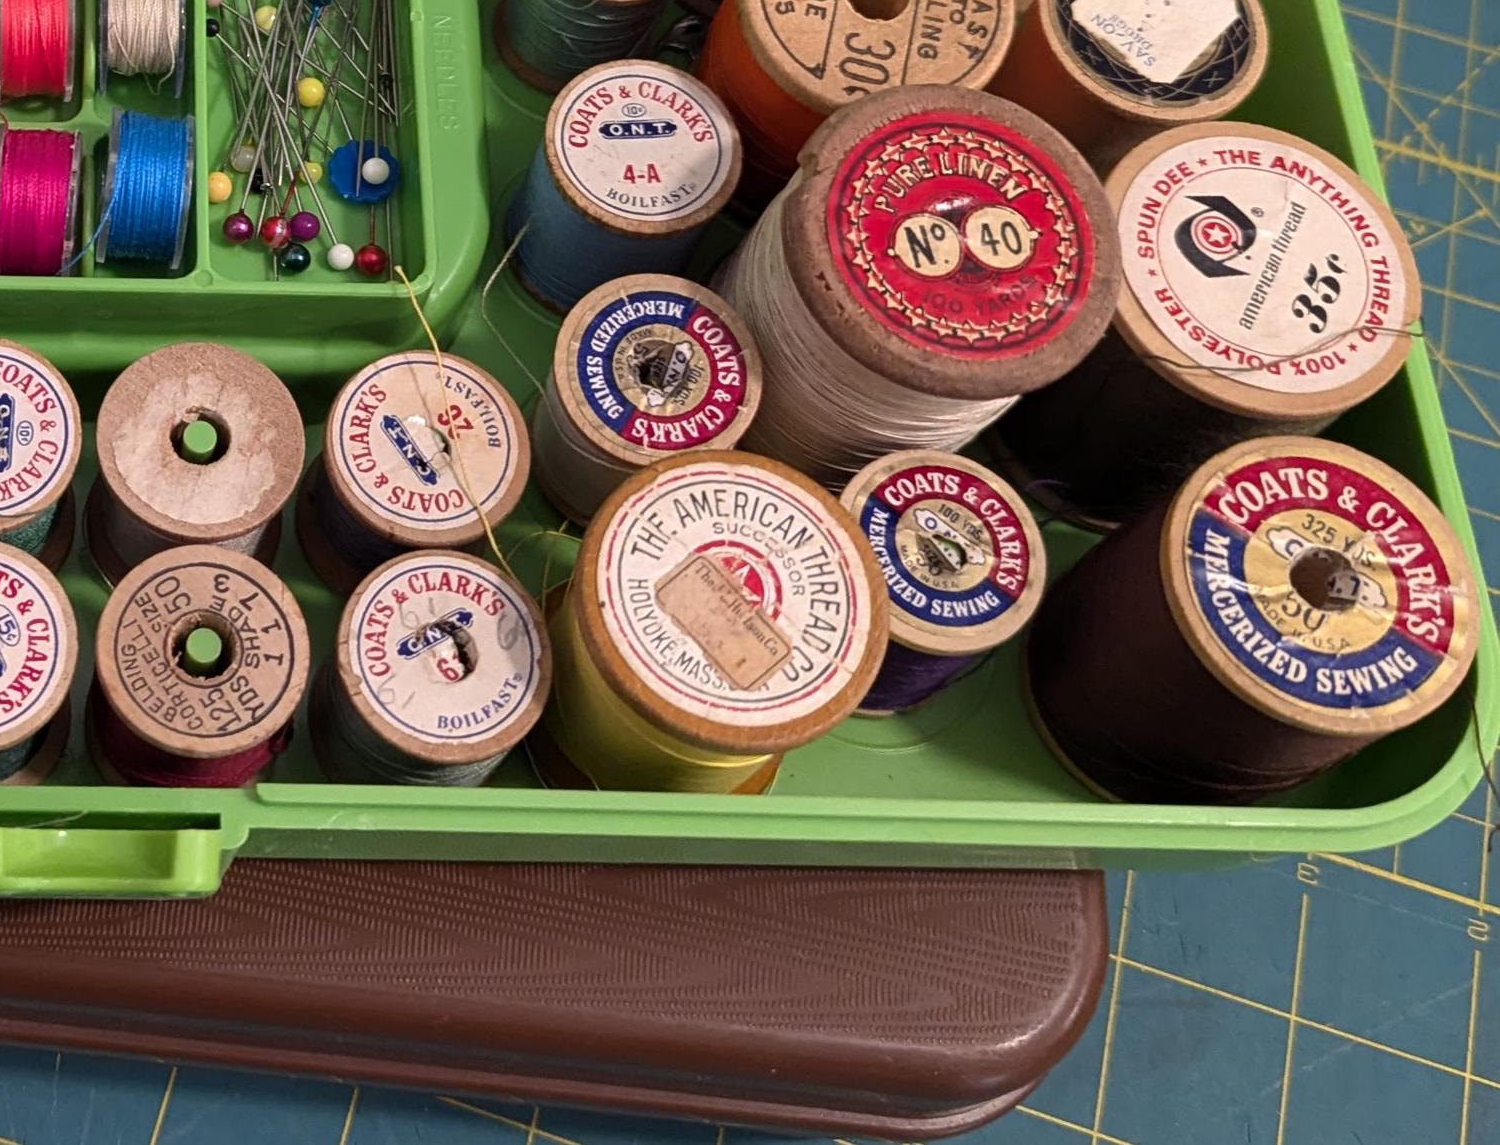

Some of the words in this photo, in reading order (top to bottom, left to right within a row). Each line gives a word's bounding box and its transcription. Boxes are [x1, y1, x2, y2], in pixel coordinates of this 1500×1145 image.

[1090, 14, 1157, 67] SAV-ON
[568, 86, 614, 149] COATS
[638, 81, 714, 143] CLARK'S
[609, 122, 671, 136] O.N.T.
[606, 184, 692, 208] BOILFAST
[622, 163, 661, 184] 4-A
[873, 158, 938, 215] PURE
[938, 151, 1029, 202] LINEN
[979, 220, 1023, 256] 40
[1137, 197, 1163, 260] SPUN
[1152, 161, 1194, 194] DEE
[1213, 149, 1262, 166] THE
[1269, 155, 1380, 249] ANYTHING
[1358, 255, 1391, 343] THREAD
[1237, 252, 1282, 331] american
[1271, 202, 1307, 255] thread
[590, 300, 686, 353] MERCERIZED
[1291, 252, 1348, 335] 35¢
[692, 315, 741, 386] COATS
[1153, 287, 1282, 376] POLYESTER
[1293, 351, 1347, 376] 100%
[444, 376, 501, 448] BOILFAST
[586, 355, 625, 420] SEWING
[349, 383, 387, 473] CLARK'S
[437, 404, 474, 440] 26
[631, 404, 725, 443] CLARK'S
[387, 486, 465, 513] COATS
[884, 472, 960, 506] COATS
[980, 498, 1028, 591] CLARK'S
[1300, 513, 1338, 543] 325
[630, 514, 676, 562] THE
[673, 488, 814, 551] AMERICAN
[800, 545, 841, 655] THREAD
[711, 522, 806, 599] SUCCESSOR
[869, 507, 928, 609] MERCERIZED
[931, 590, 1000, 618] SEWING
[920, 573, 929, 583] IN
[1217, 467, 1329, 526] COATS
[1337, 486, 1363, 514] &
[1365, 502, 1447, 643] CLARK'S
[154, 576, 191, 614] 50
[364, 600, 395, 677] COATS
[408, 571, 506, 617] CLARK'S
[1204, 528, 1308, 683] MERCERIZED
[1315, 646, 1418, 695] SEWING
[209, 595, 261, 669] SHADE
[121, 644, 178, 723] BELDING
[123, 619, 204, 730] CORTICELLI
[230, 675, 265, 724] YDS
[437, 677, 517, 730] BOILFAST
[199, 688, 242, 732] 125
